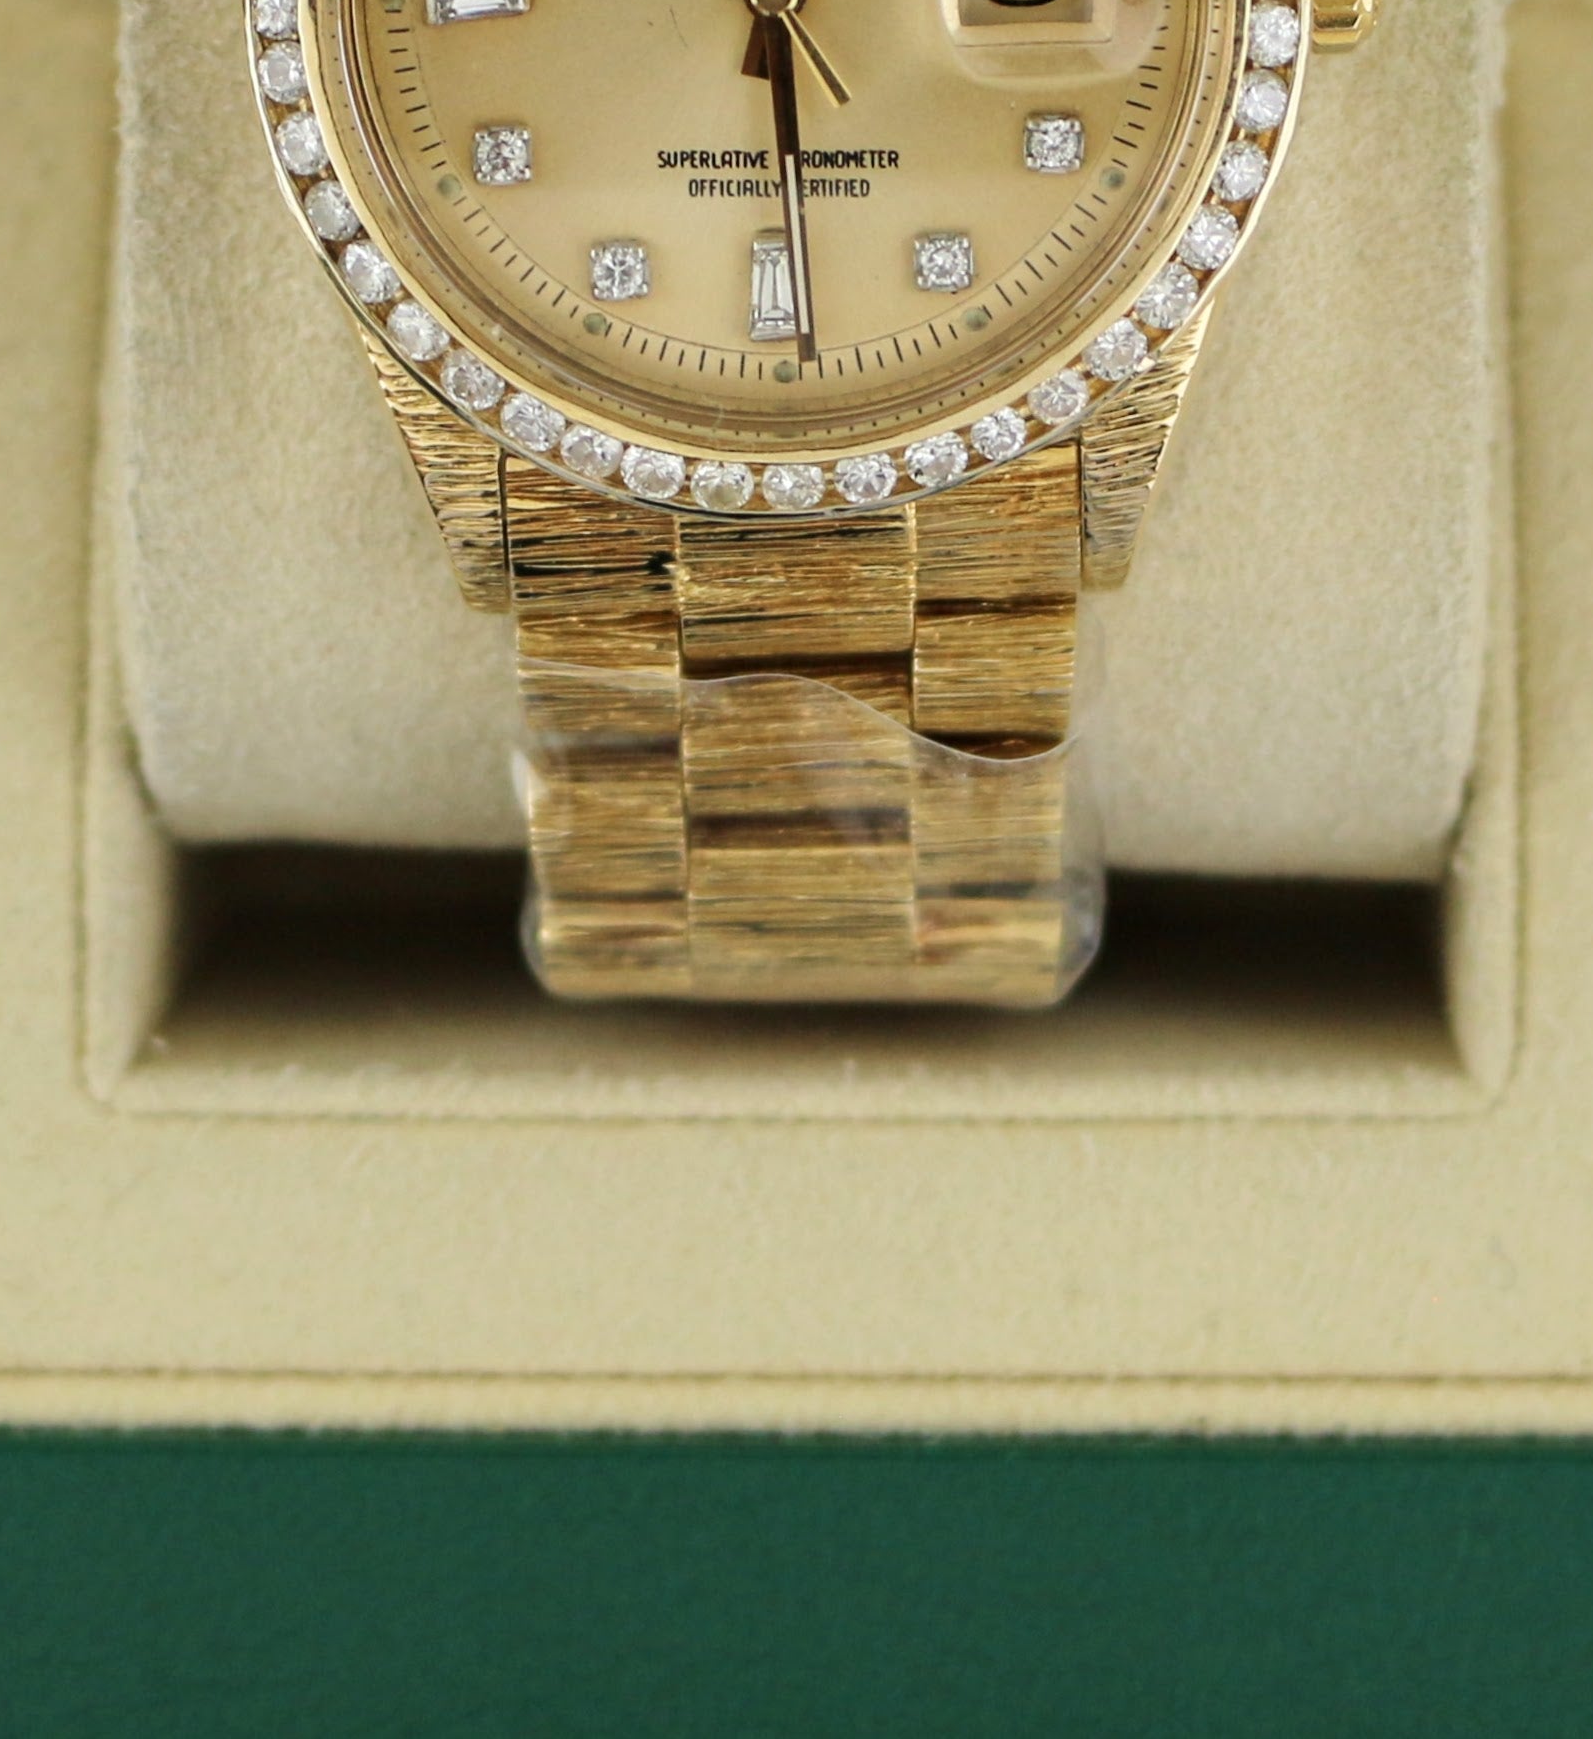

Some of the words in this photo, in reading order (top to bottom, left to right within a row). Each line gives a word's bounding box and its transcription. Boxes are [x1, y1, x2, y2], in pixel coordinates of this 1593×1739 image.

[657, 149, 770, 169] SUPERLATIVE
[800, 149, 900, 169] RONOMETER
[688, 178, 782, 198] OFFICIALLY
[802, 178, 871, 198] ERTIFIED
